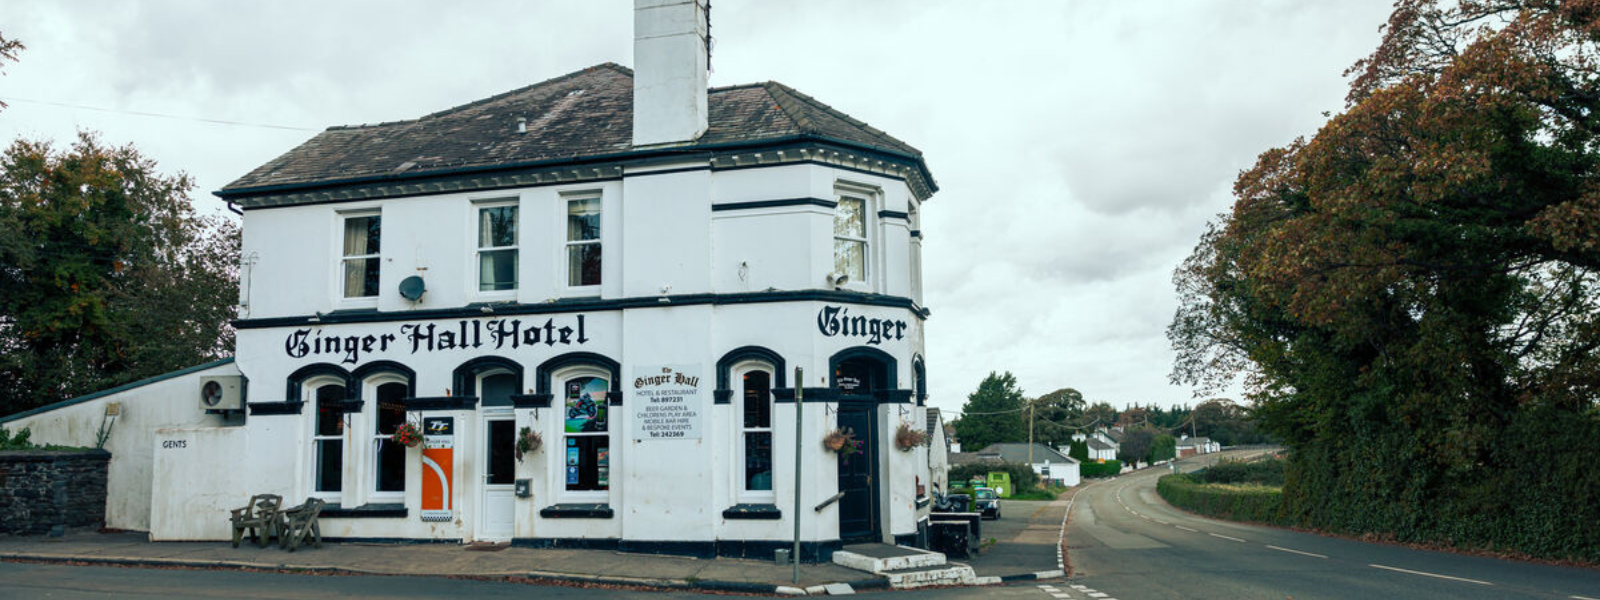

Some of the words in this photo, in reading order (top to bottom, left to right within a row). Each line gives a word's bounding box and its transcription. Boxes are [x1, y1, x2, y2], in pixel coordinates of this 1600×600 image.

[285, 327, 396, 364] Ginger
[400, 319, 483, 354] Hall
[486, 314, 589, 350] Hotel
[817, 305, 907, 345] Ginger
[634, 375, 671, 389] Ginger
[674, 372, 699, 388] Hall
[162, 440, 187, 449] GENTS
